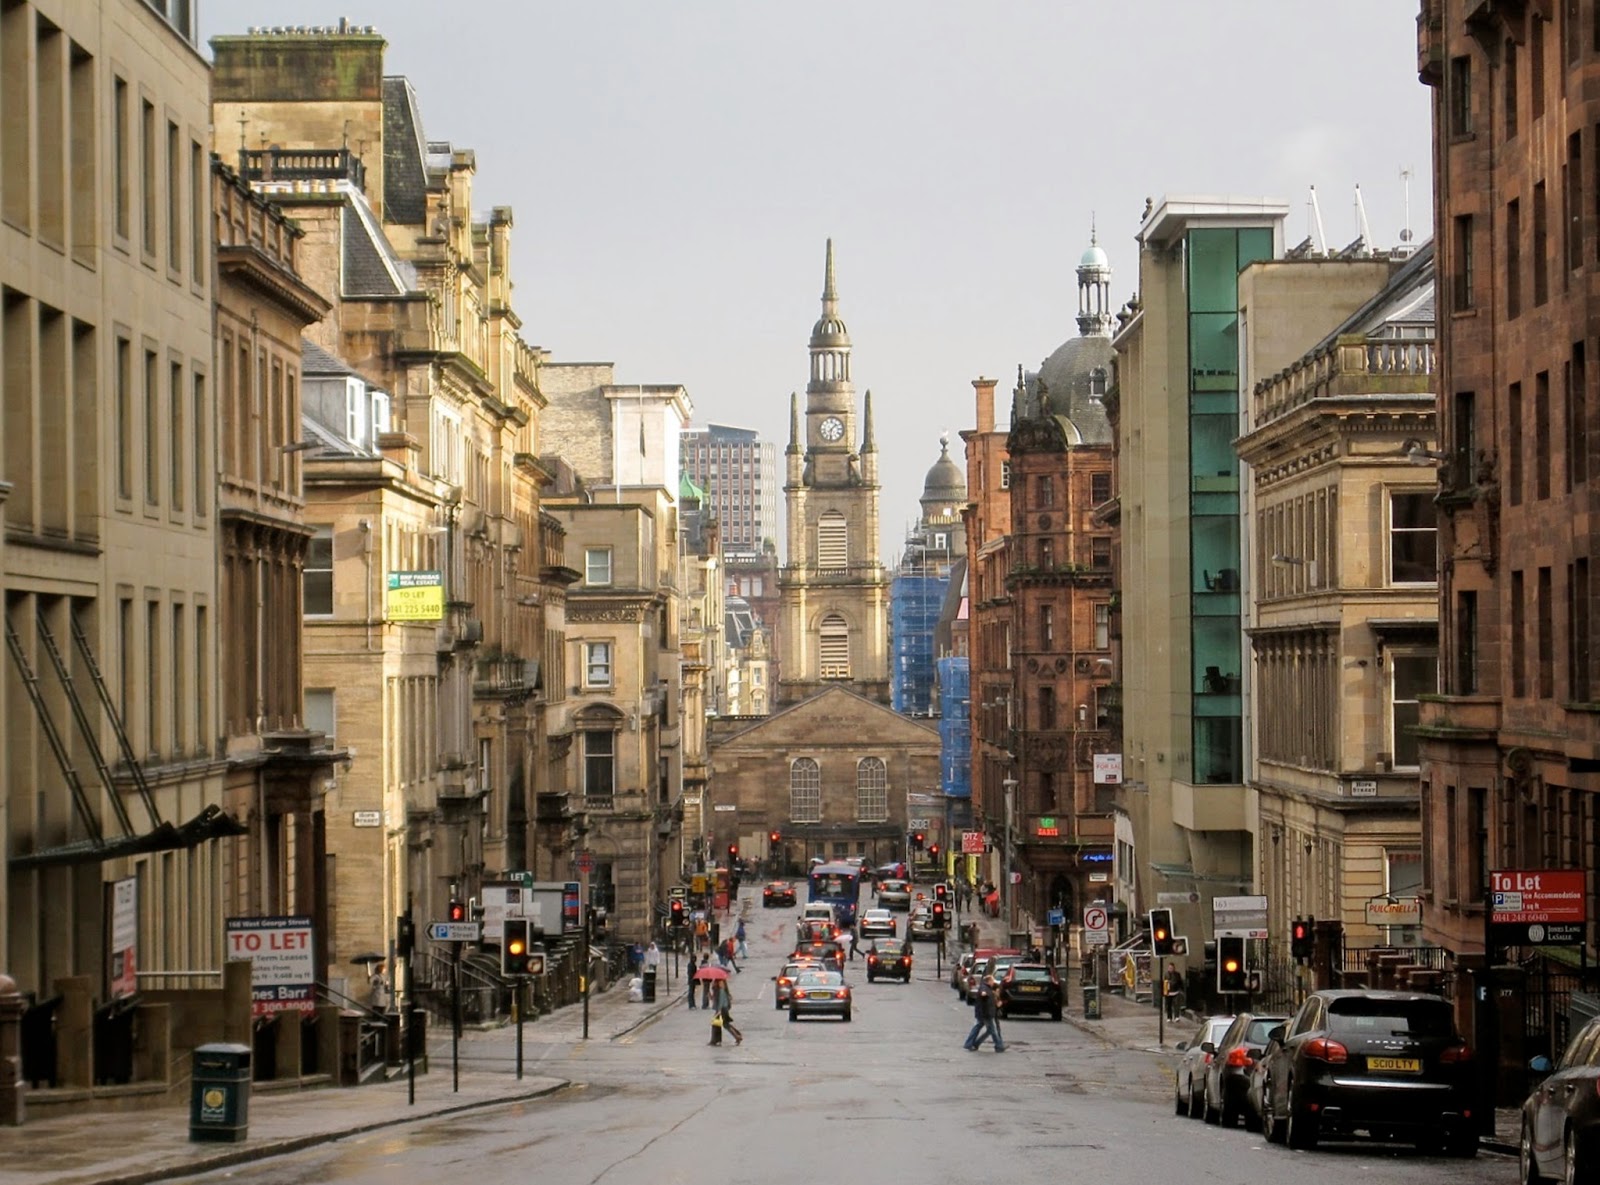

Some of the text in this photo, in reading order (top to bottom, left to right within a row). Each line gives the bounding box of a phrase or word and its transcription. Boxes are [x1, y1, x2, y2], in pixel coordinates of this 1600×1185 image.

[405, 604, 419, 613] 225
[421, 604, 440, 613] 5440
[962, 832, 978, 840] DTZ
[510, 872, 525, 881] LET
[1492, 873, 1541, 890] To Let
[1369, 904, 1418, 913] PULCINELLA
[1492, 913, 1549, 922] 0141 248 6040
[261, 919, 287, 927] George
[288, 918, 311, 926] Street
[449, 924, 476, 932] Mitchell
[230, 931, 309, 951] TO LET
[278, 986, 307, 999] Barr
[1395, 1059, 1414, 1069] LTY
